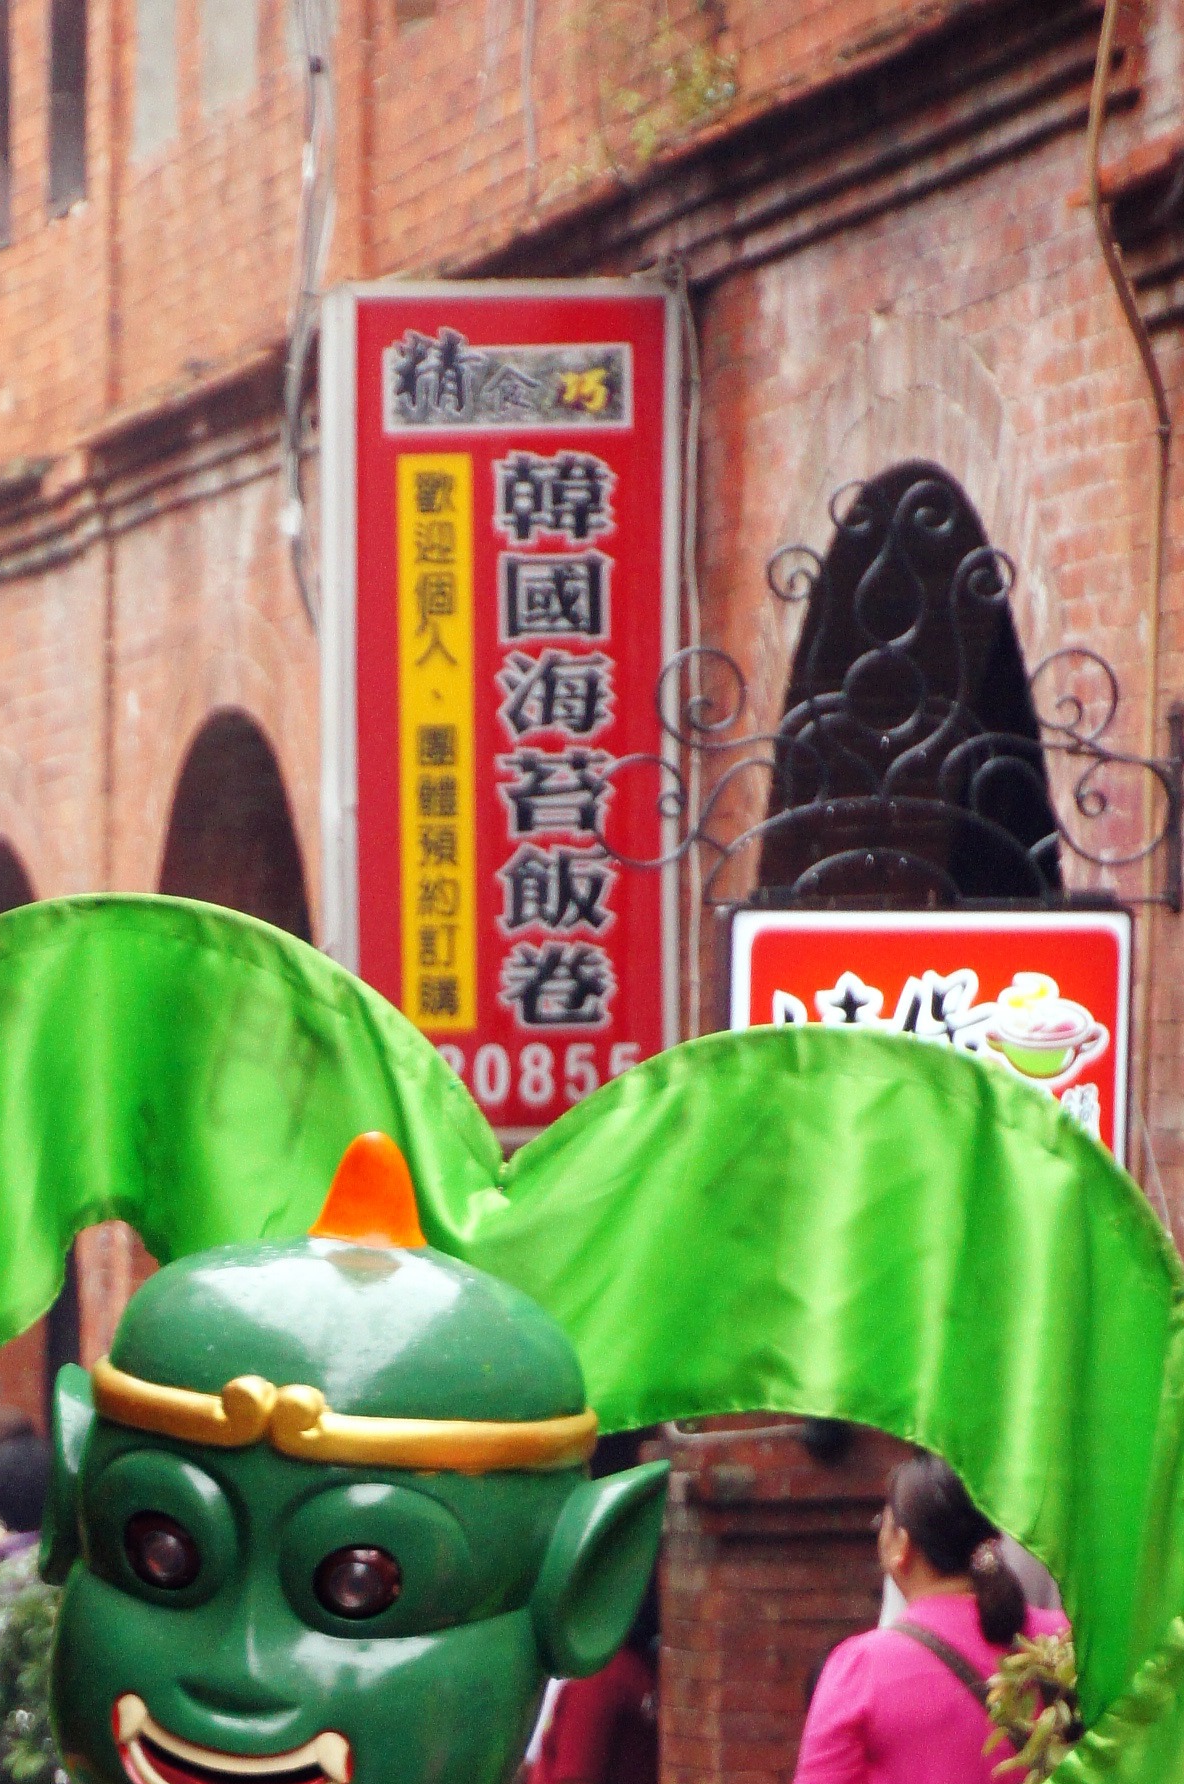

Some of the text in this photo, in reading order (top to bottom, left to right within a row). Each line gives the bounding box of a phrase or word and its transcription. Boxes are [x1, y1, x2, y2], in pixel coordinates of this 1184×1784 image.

[494, 450, 616, 1030] 韓國海苔飯卷
